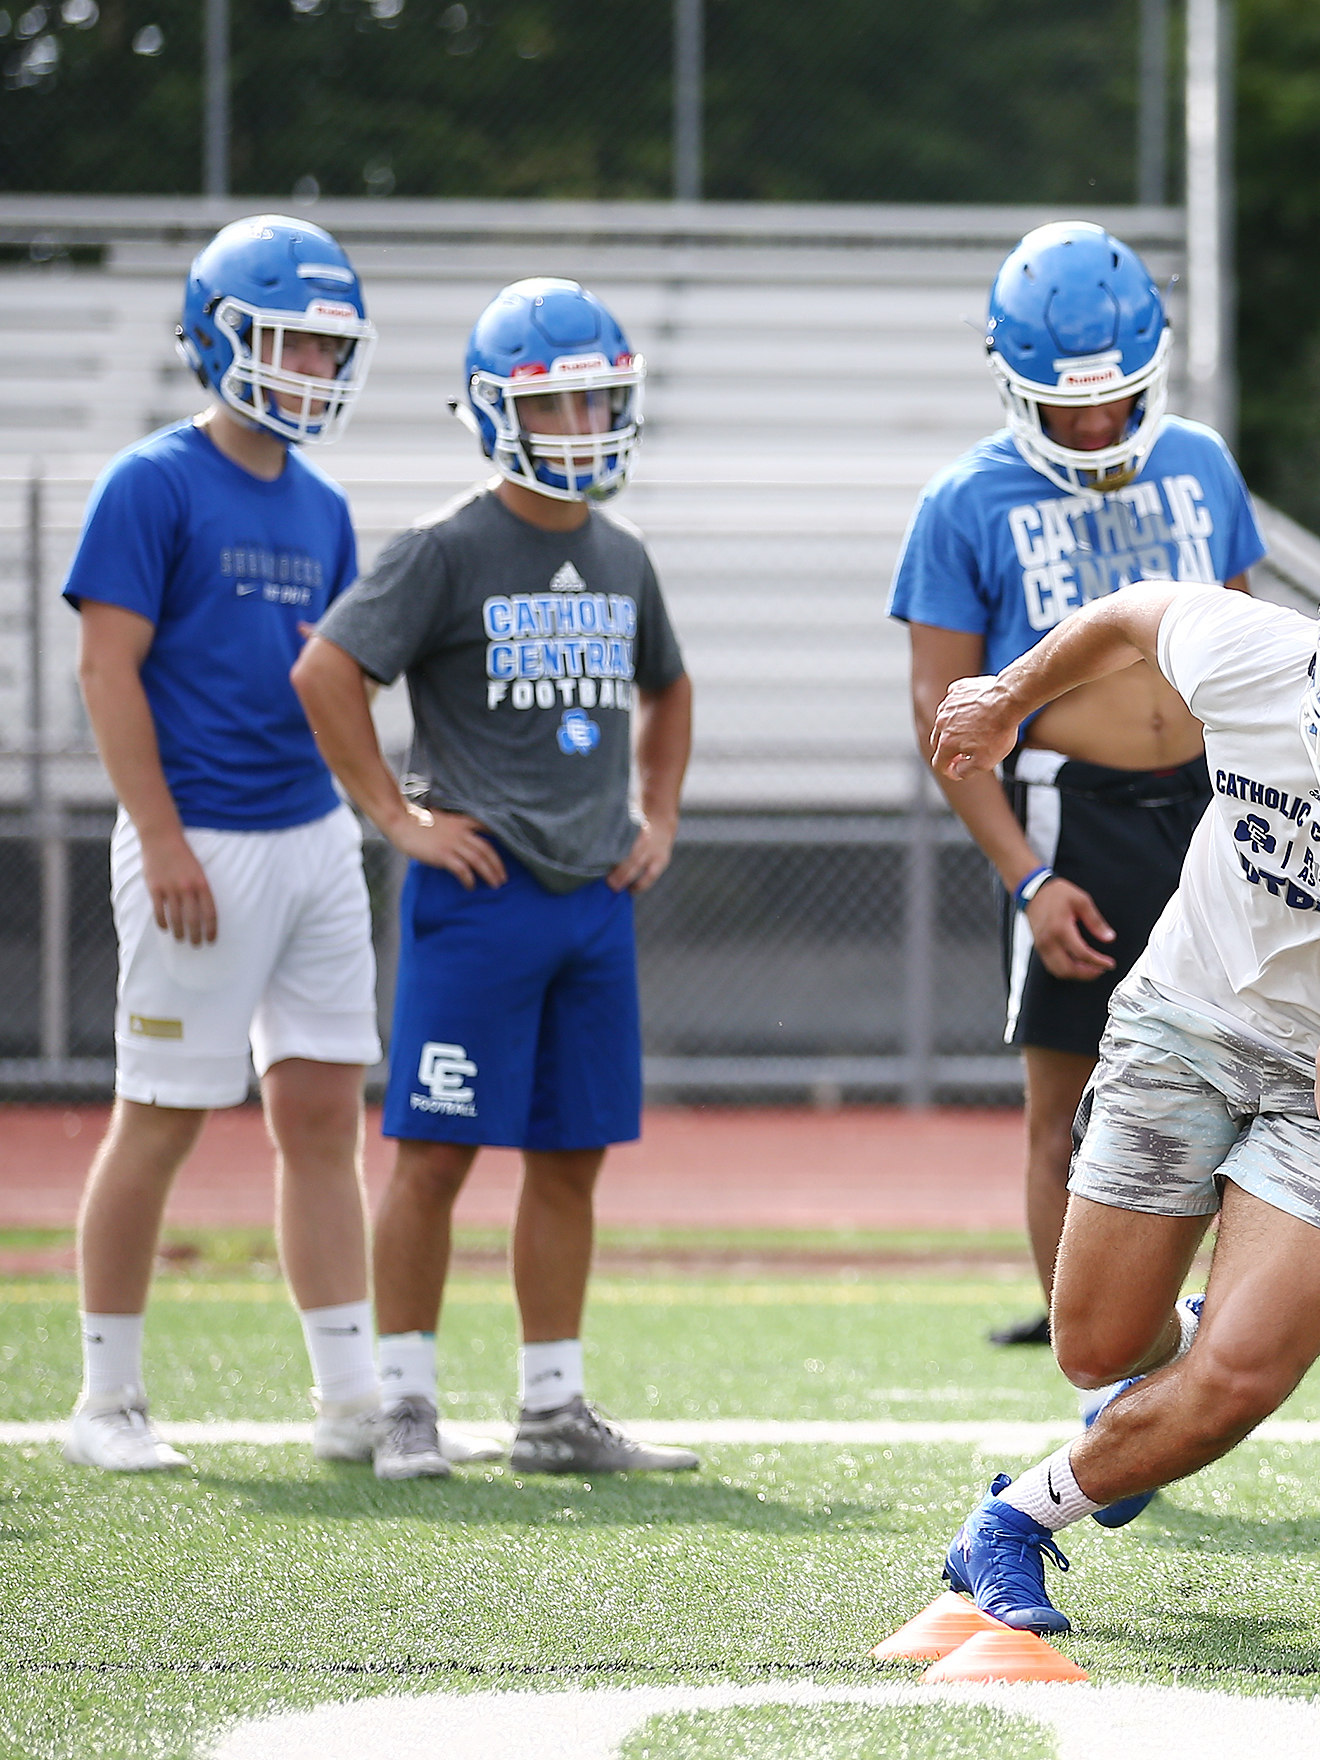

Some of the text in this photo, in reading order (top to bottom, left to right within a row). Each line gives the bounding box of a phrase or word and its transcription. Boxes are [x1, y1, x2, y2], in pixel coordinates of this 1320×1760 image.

[1008, 474, 1214, 570] CATHOLIC
[483, 593, 637, 641] CATHOLIC
[487, 637, 635, 681] CENTRAL
[1216, 769, 1312, 828] CATHOLIC
[1297, 865, 1316, 887] AS
